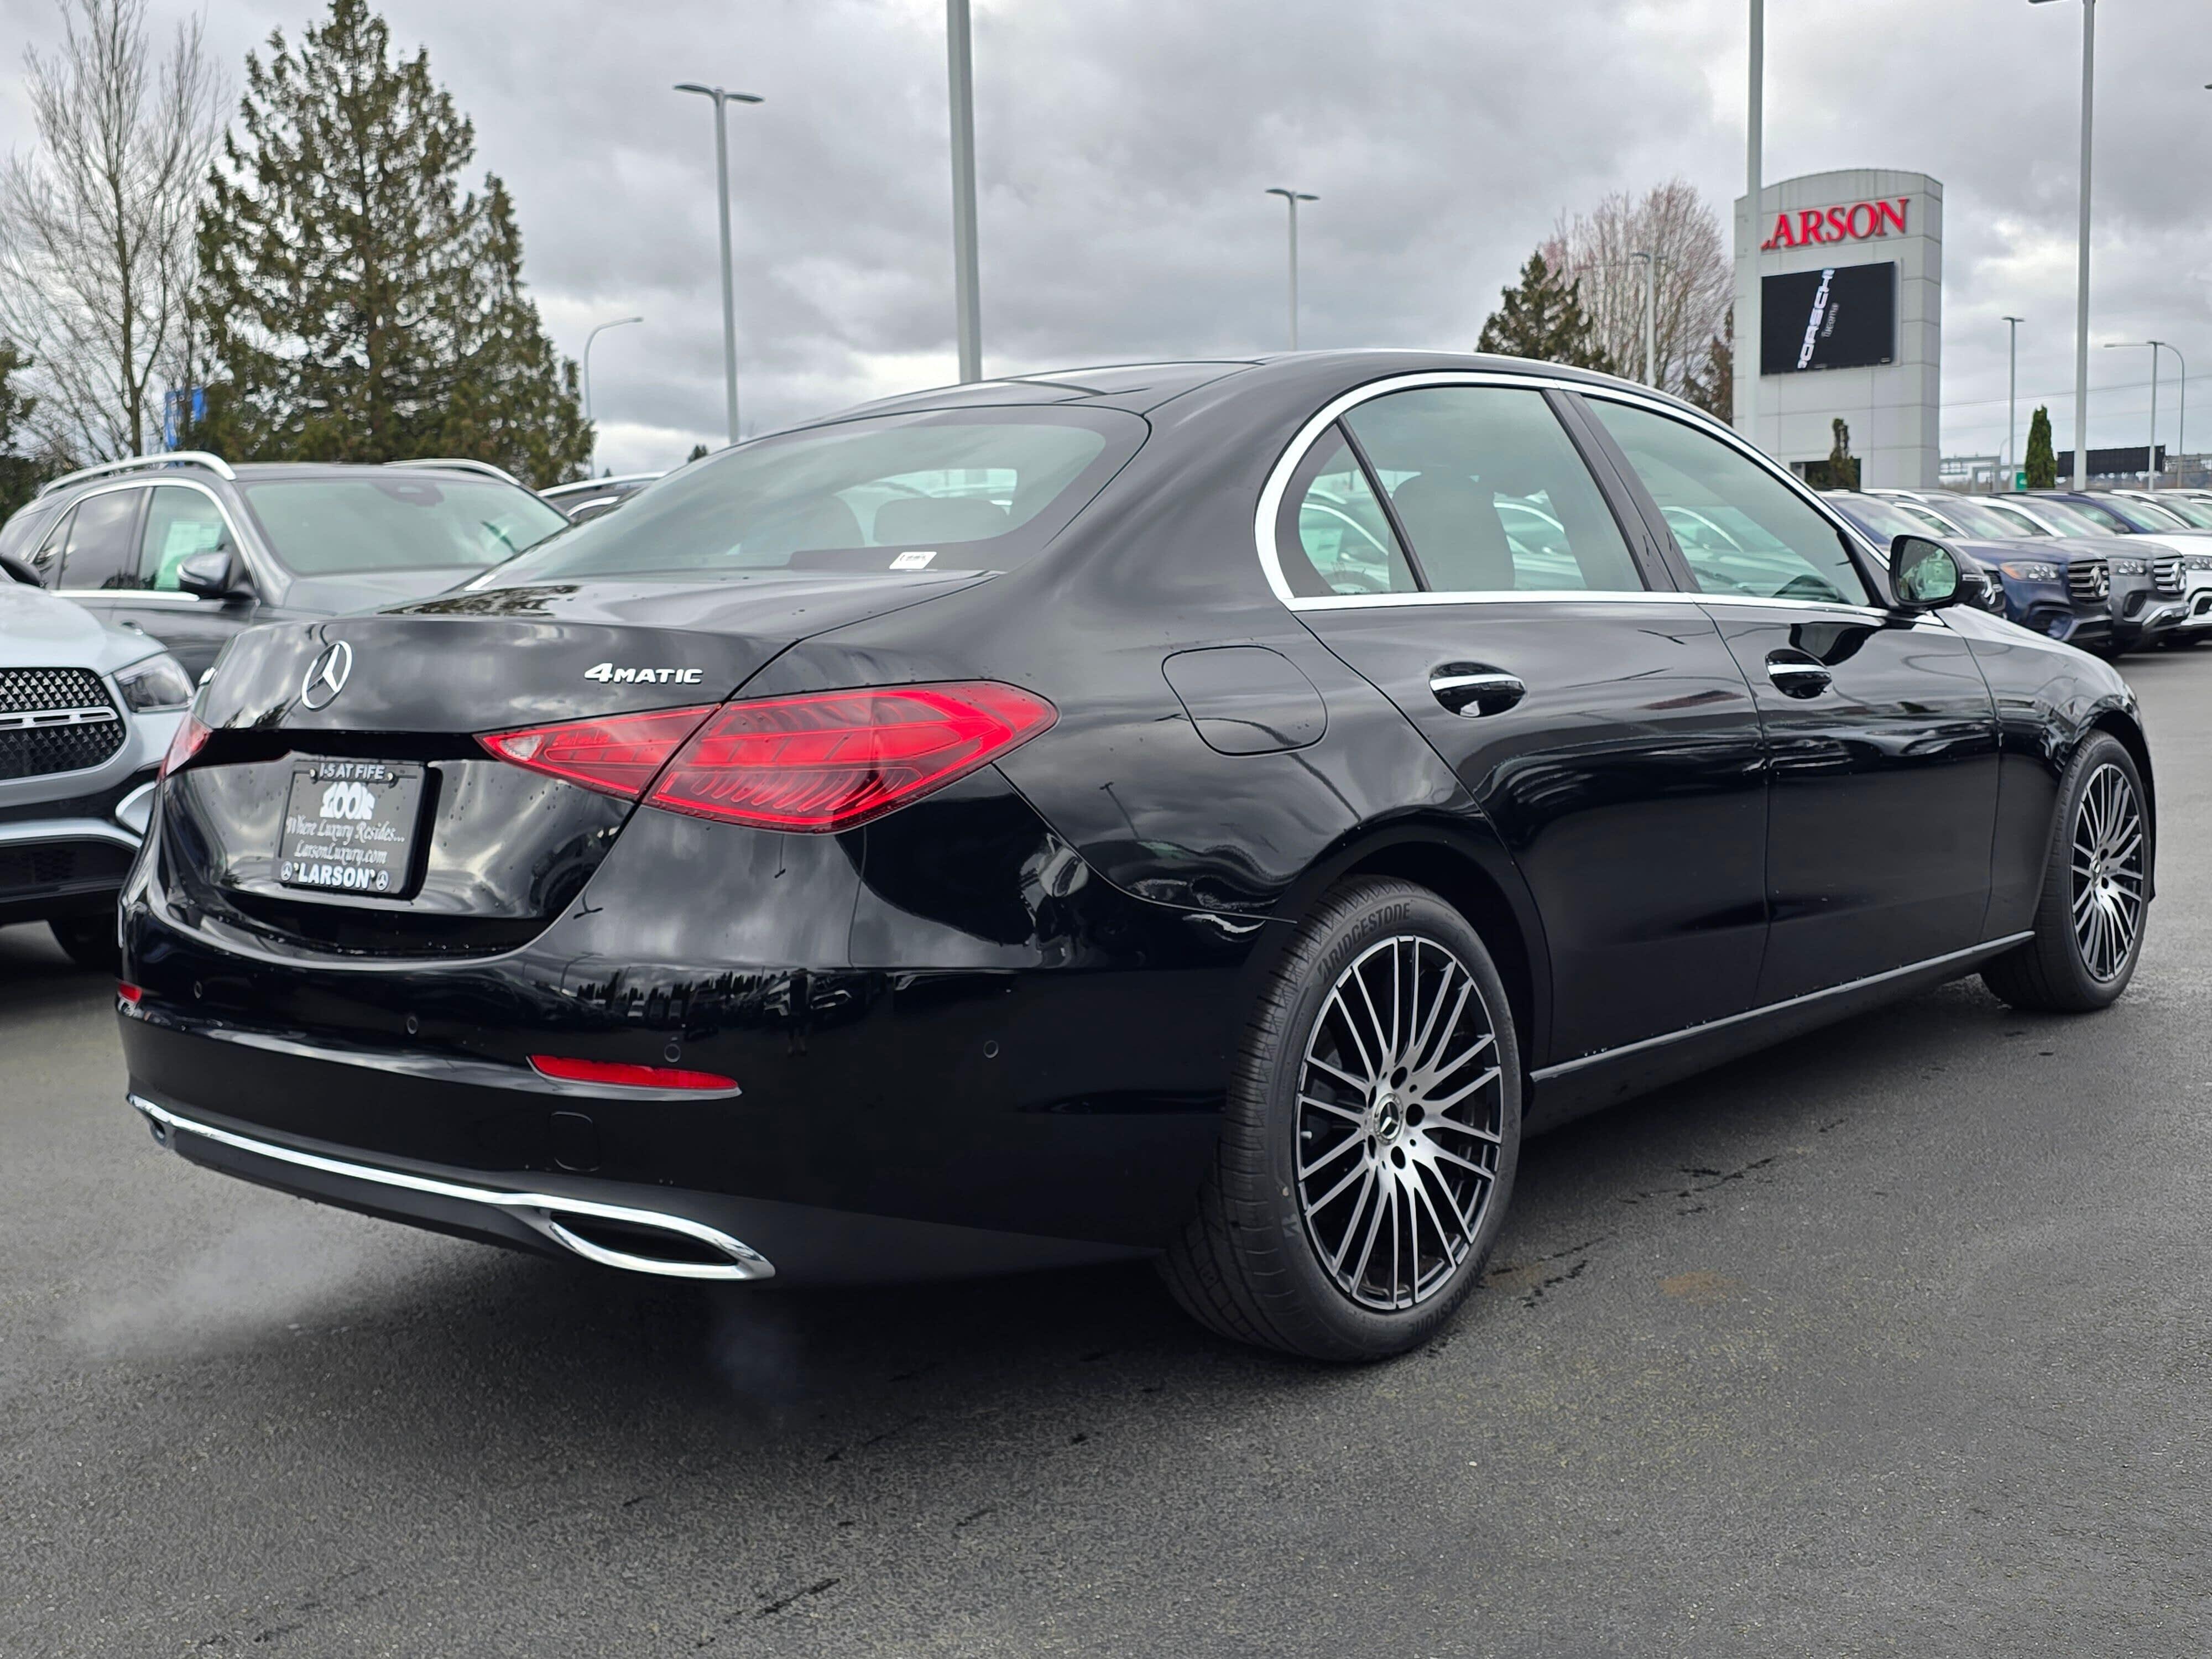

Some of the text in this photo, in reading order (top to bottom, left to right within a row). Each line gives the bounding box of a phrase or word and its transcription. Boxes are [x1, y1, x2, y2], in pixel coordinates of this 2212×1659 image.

[1761, 198, 1910, 251] ARSON
[584, 662, 703, 684] 4MATIC
[335, 764, 354, 779] AT
[354, 764, 385, 780] FIFE
[317, 818, 354, 846] Luxury
[298, 862, 369, 889] LARSON
[1317, 902, 1411, 985] BRIDGESTONE
